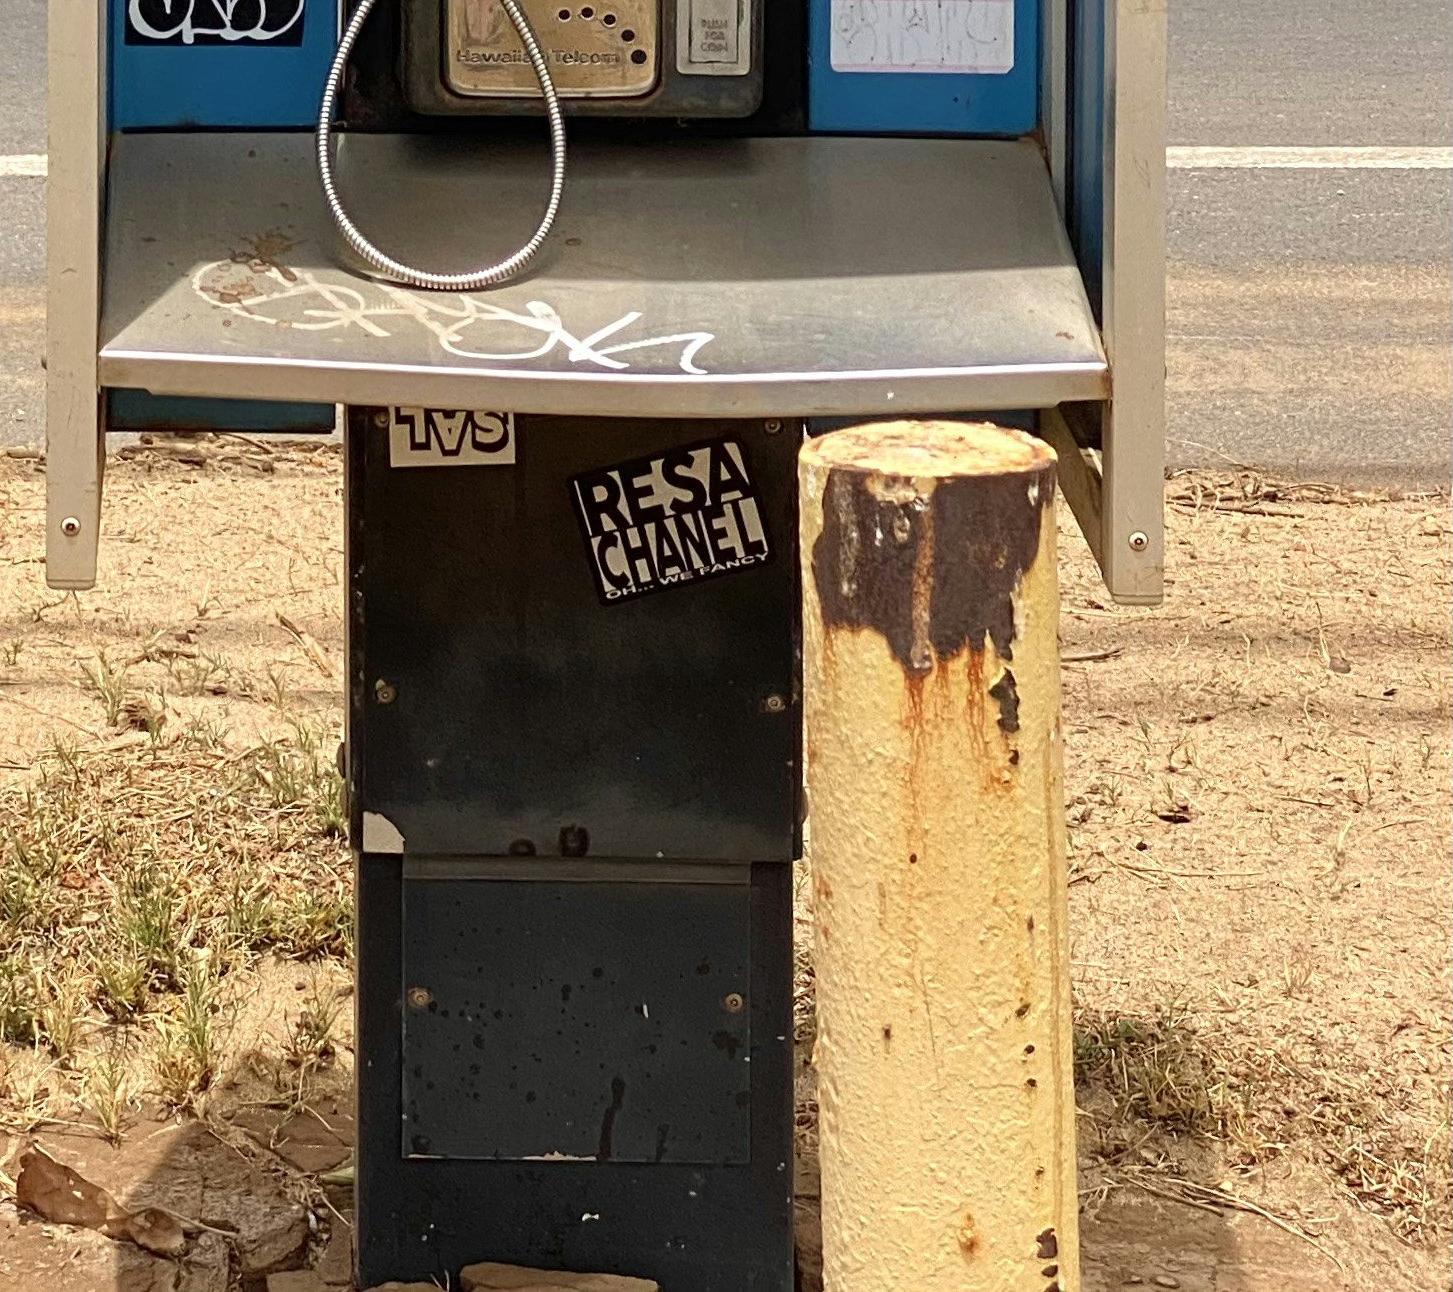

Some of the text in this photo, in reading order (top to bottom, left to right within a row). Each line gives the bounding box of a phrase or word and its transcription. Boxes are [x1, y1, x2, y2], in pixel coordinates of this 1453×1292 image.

[700, 18, 730, 30] PUSH
[456, 48, 622, 65] Hawaiia Telcom
[577, 440, 752, 534] RESA
[596, 496, 769, 592] CHANEL
[659, 570, 694, 586] WE
[699, 551, 770, 577] FANCY
